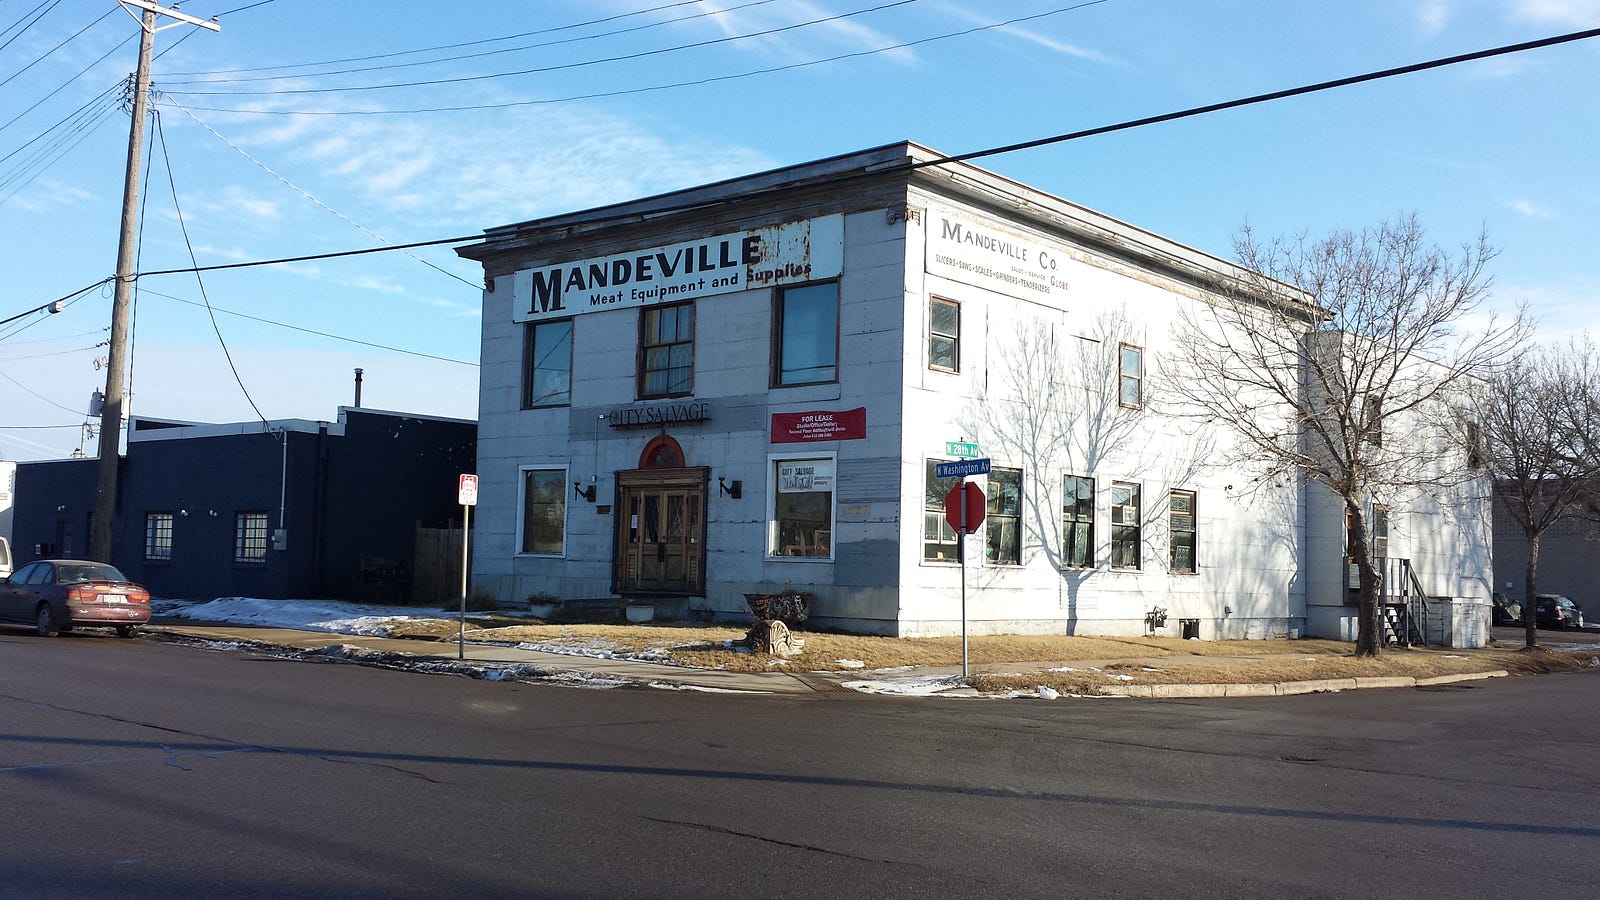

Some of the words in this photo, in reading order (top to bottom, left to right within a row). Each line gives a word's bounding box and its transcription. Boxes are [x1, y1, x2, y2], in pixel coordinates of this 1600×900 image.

[941, 218, 1027, 261] MANDEVILLE
[527, 234, 762, 314] MANDEVILLE
[590, 291, 623, 306] Meat
[631, 278, 706, 303] Equipment
[711, 272, 739, 288] and
[747, 261, 812, 284] Supplies
[609, 407, 644, 426] CITY
[646, 403, 709, 424] SALVAGE
[801, 415, 814, 423] FOR
[815, 414, 834, 422] LEASE
[946, 443, 952, 455] N
[953, 444, 969, 455] 28th
[970, 445, 978, 457] Av
[937, 465, 942, 476] N
[943, 463, 979, 475] Washington
[981, 462, 990, 472] Av
